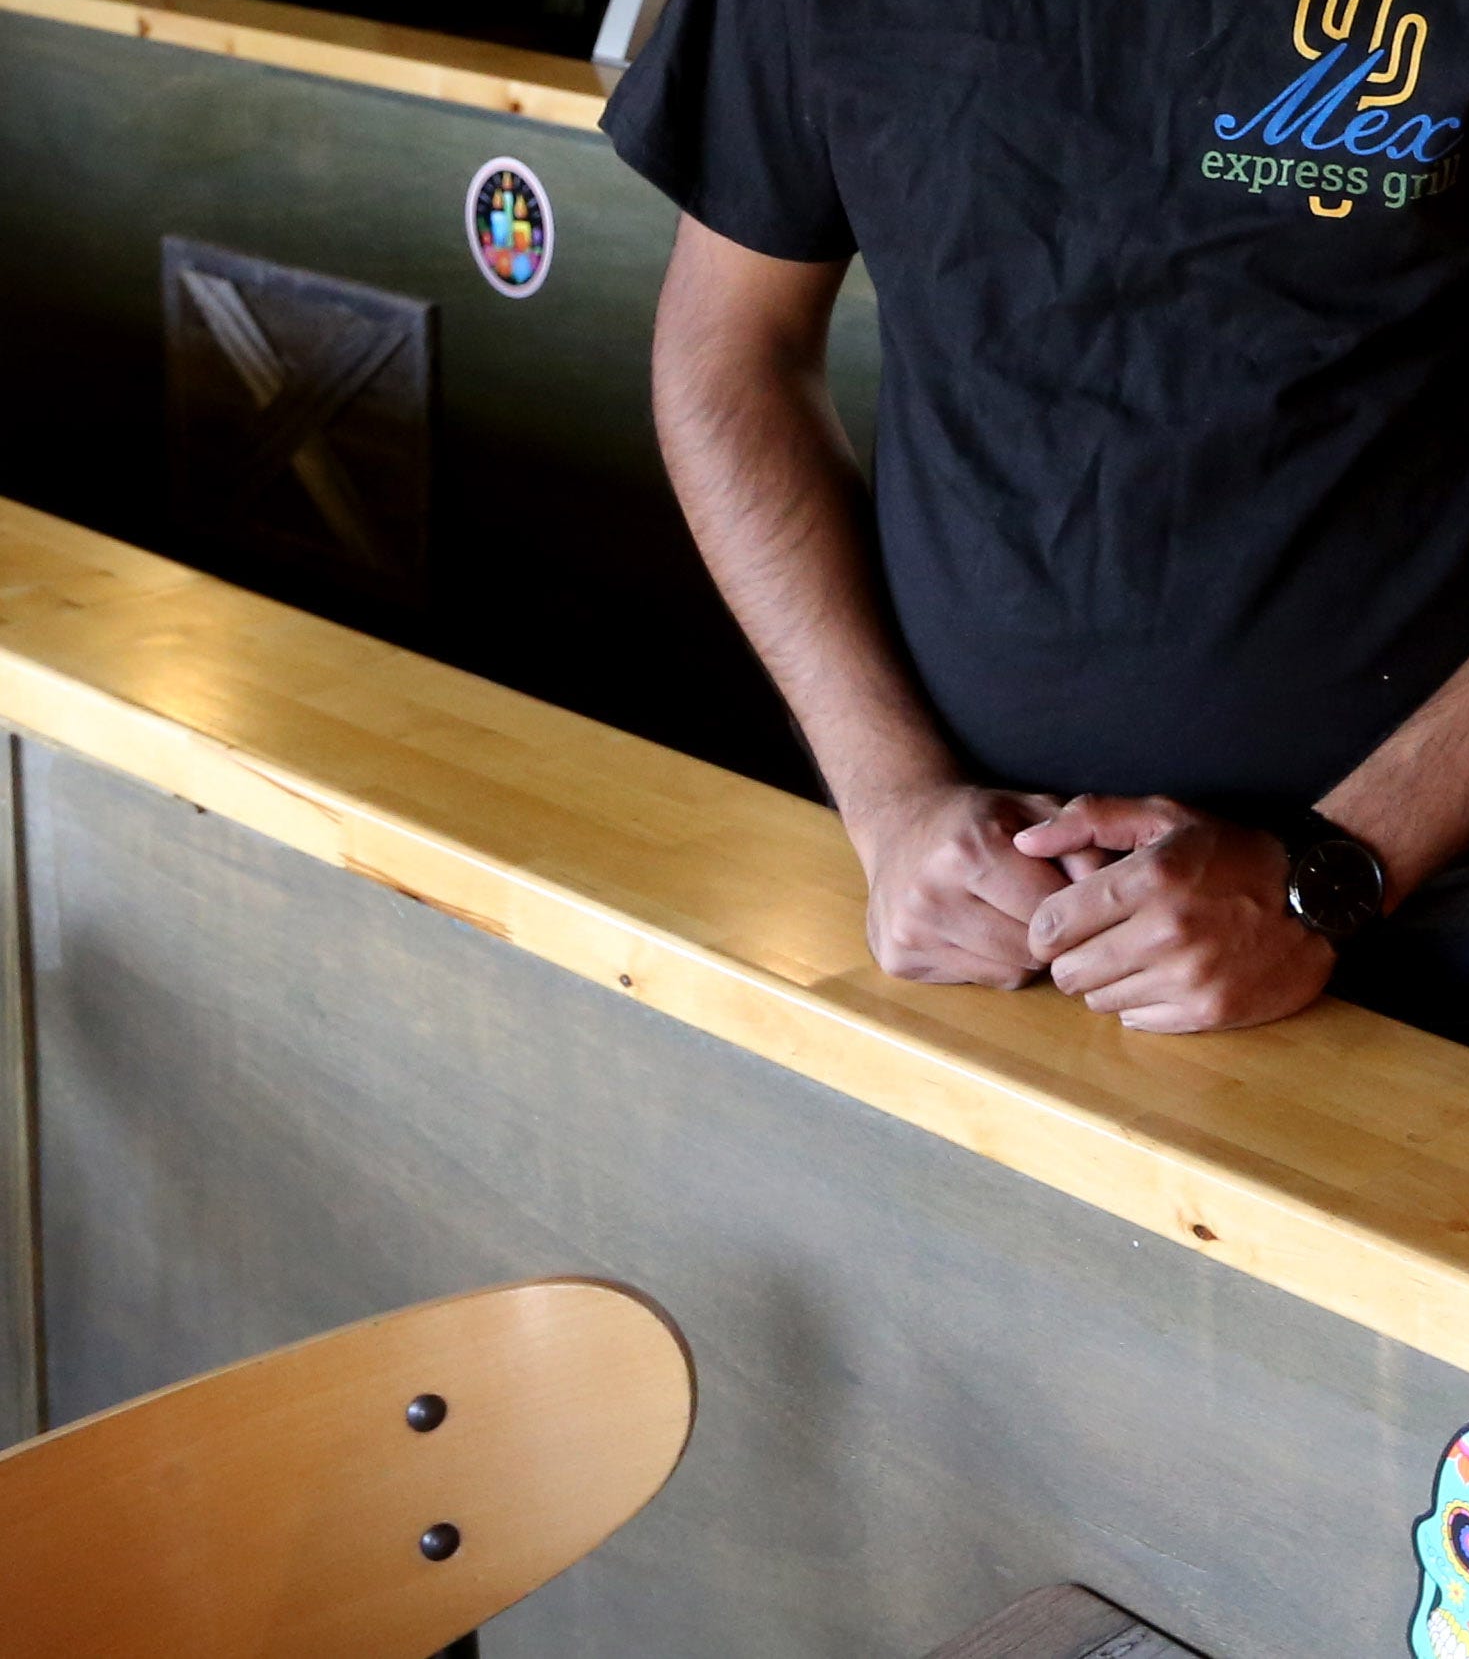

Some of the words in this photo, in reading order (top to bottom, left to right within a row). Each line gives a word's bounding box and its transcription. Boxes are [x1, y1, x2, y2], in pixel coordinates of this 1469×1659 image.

[1214, 42, 1464, 163] Mex
[1201, 150, 1369, 195] express
[1382, 154, 1460, 209] grill
